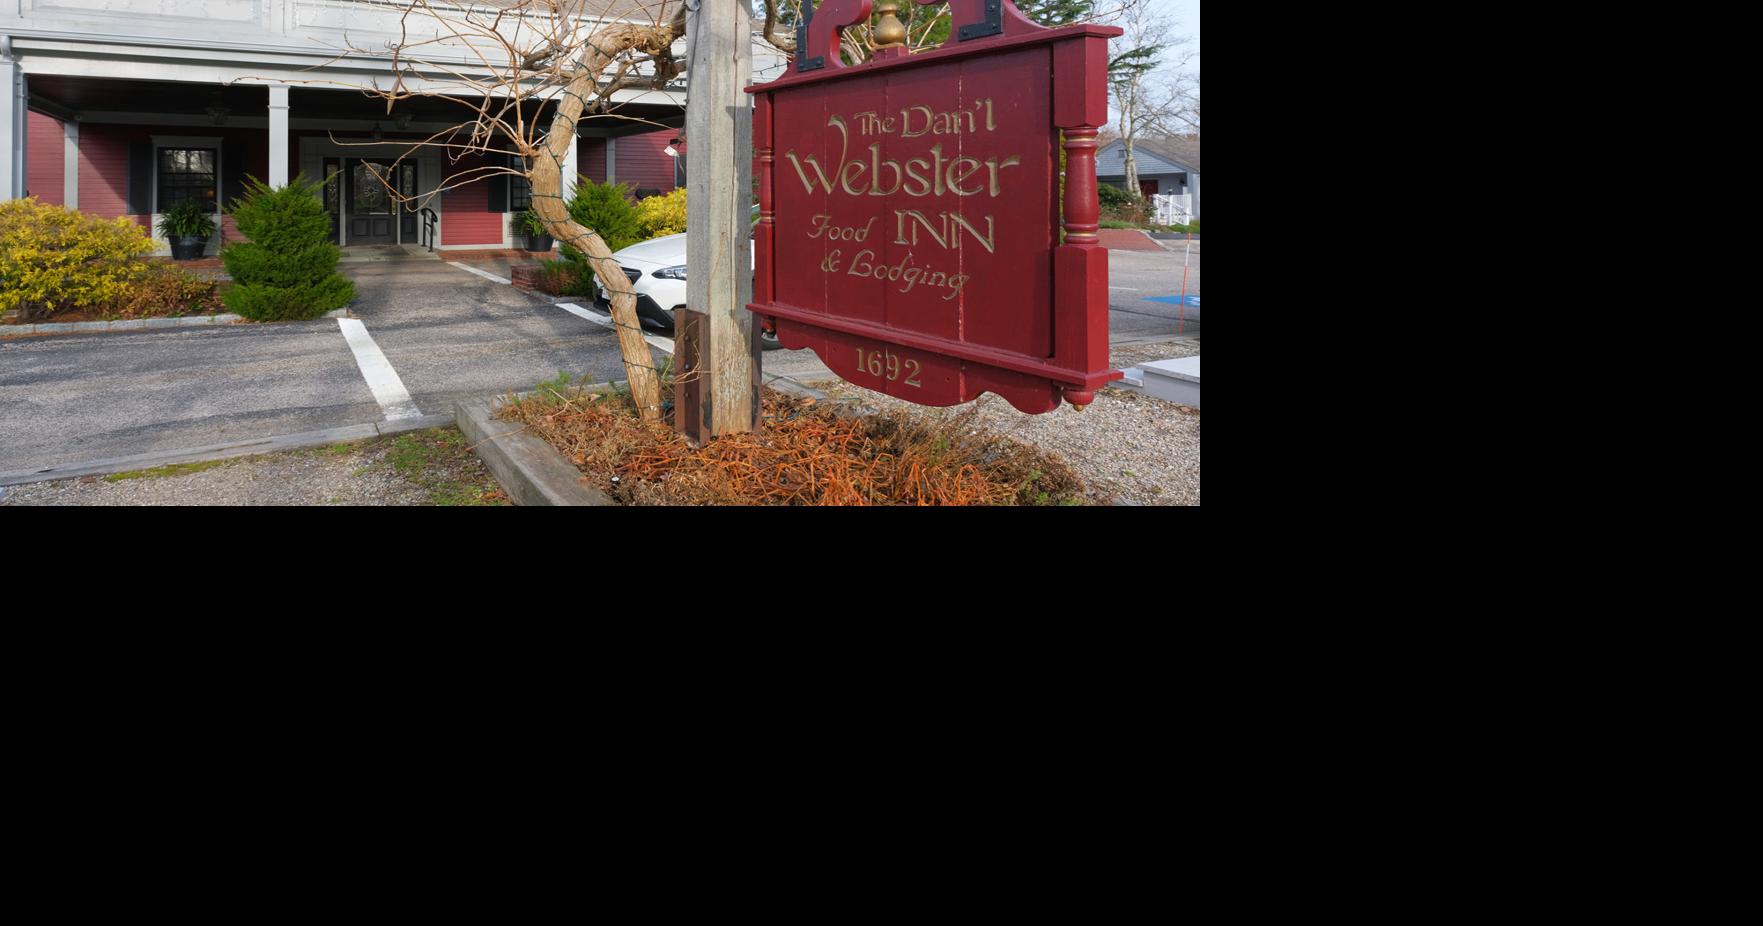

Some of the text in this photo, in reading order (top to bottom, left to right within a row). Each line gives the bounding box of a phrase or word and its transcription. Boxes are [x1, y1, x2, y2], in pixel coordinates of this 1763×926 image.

[854, 98, 996, 137] The Dan'l
[785, 114, 1020, 197] Webster
[806, 213, 878, 242] Food
[894, 209, 995, 254] INN
[820, 249, 970, 300] & Lodging
[856, 346, 922, 388] 1692
